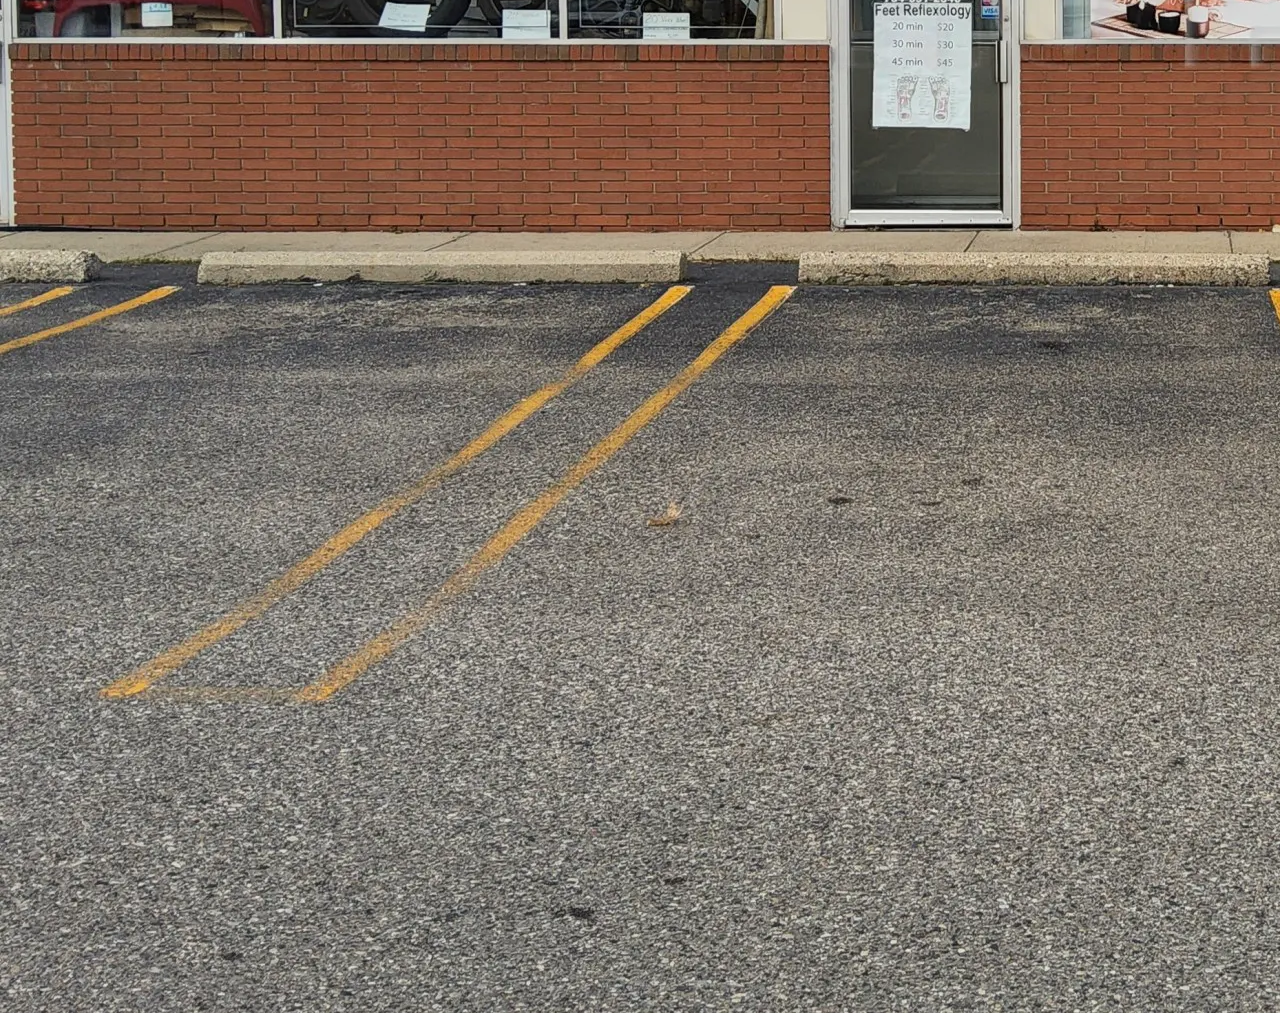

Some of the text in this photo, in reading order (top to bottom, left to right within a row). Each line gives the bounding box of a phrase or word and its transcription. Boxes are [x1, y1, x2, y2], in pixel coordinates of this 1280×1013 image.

[875, 4, 972, 19] Feet Reflexology
[892, 21, 954, 32] 20 min $20
[892, 39, 954, 50] 30 min $30
[891, 57, 953, 68] 45 min $45
